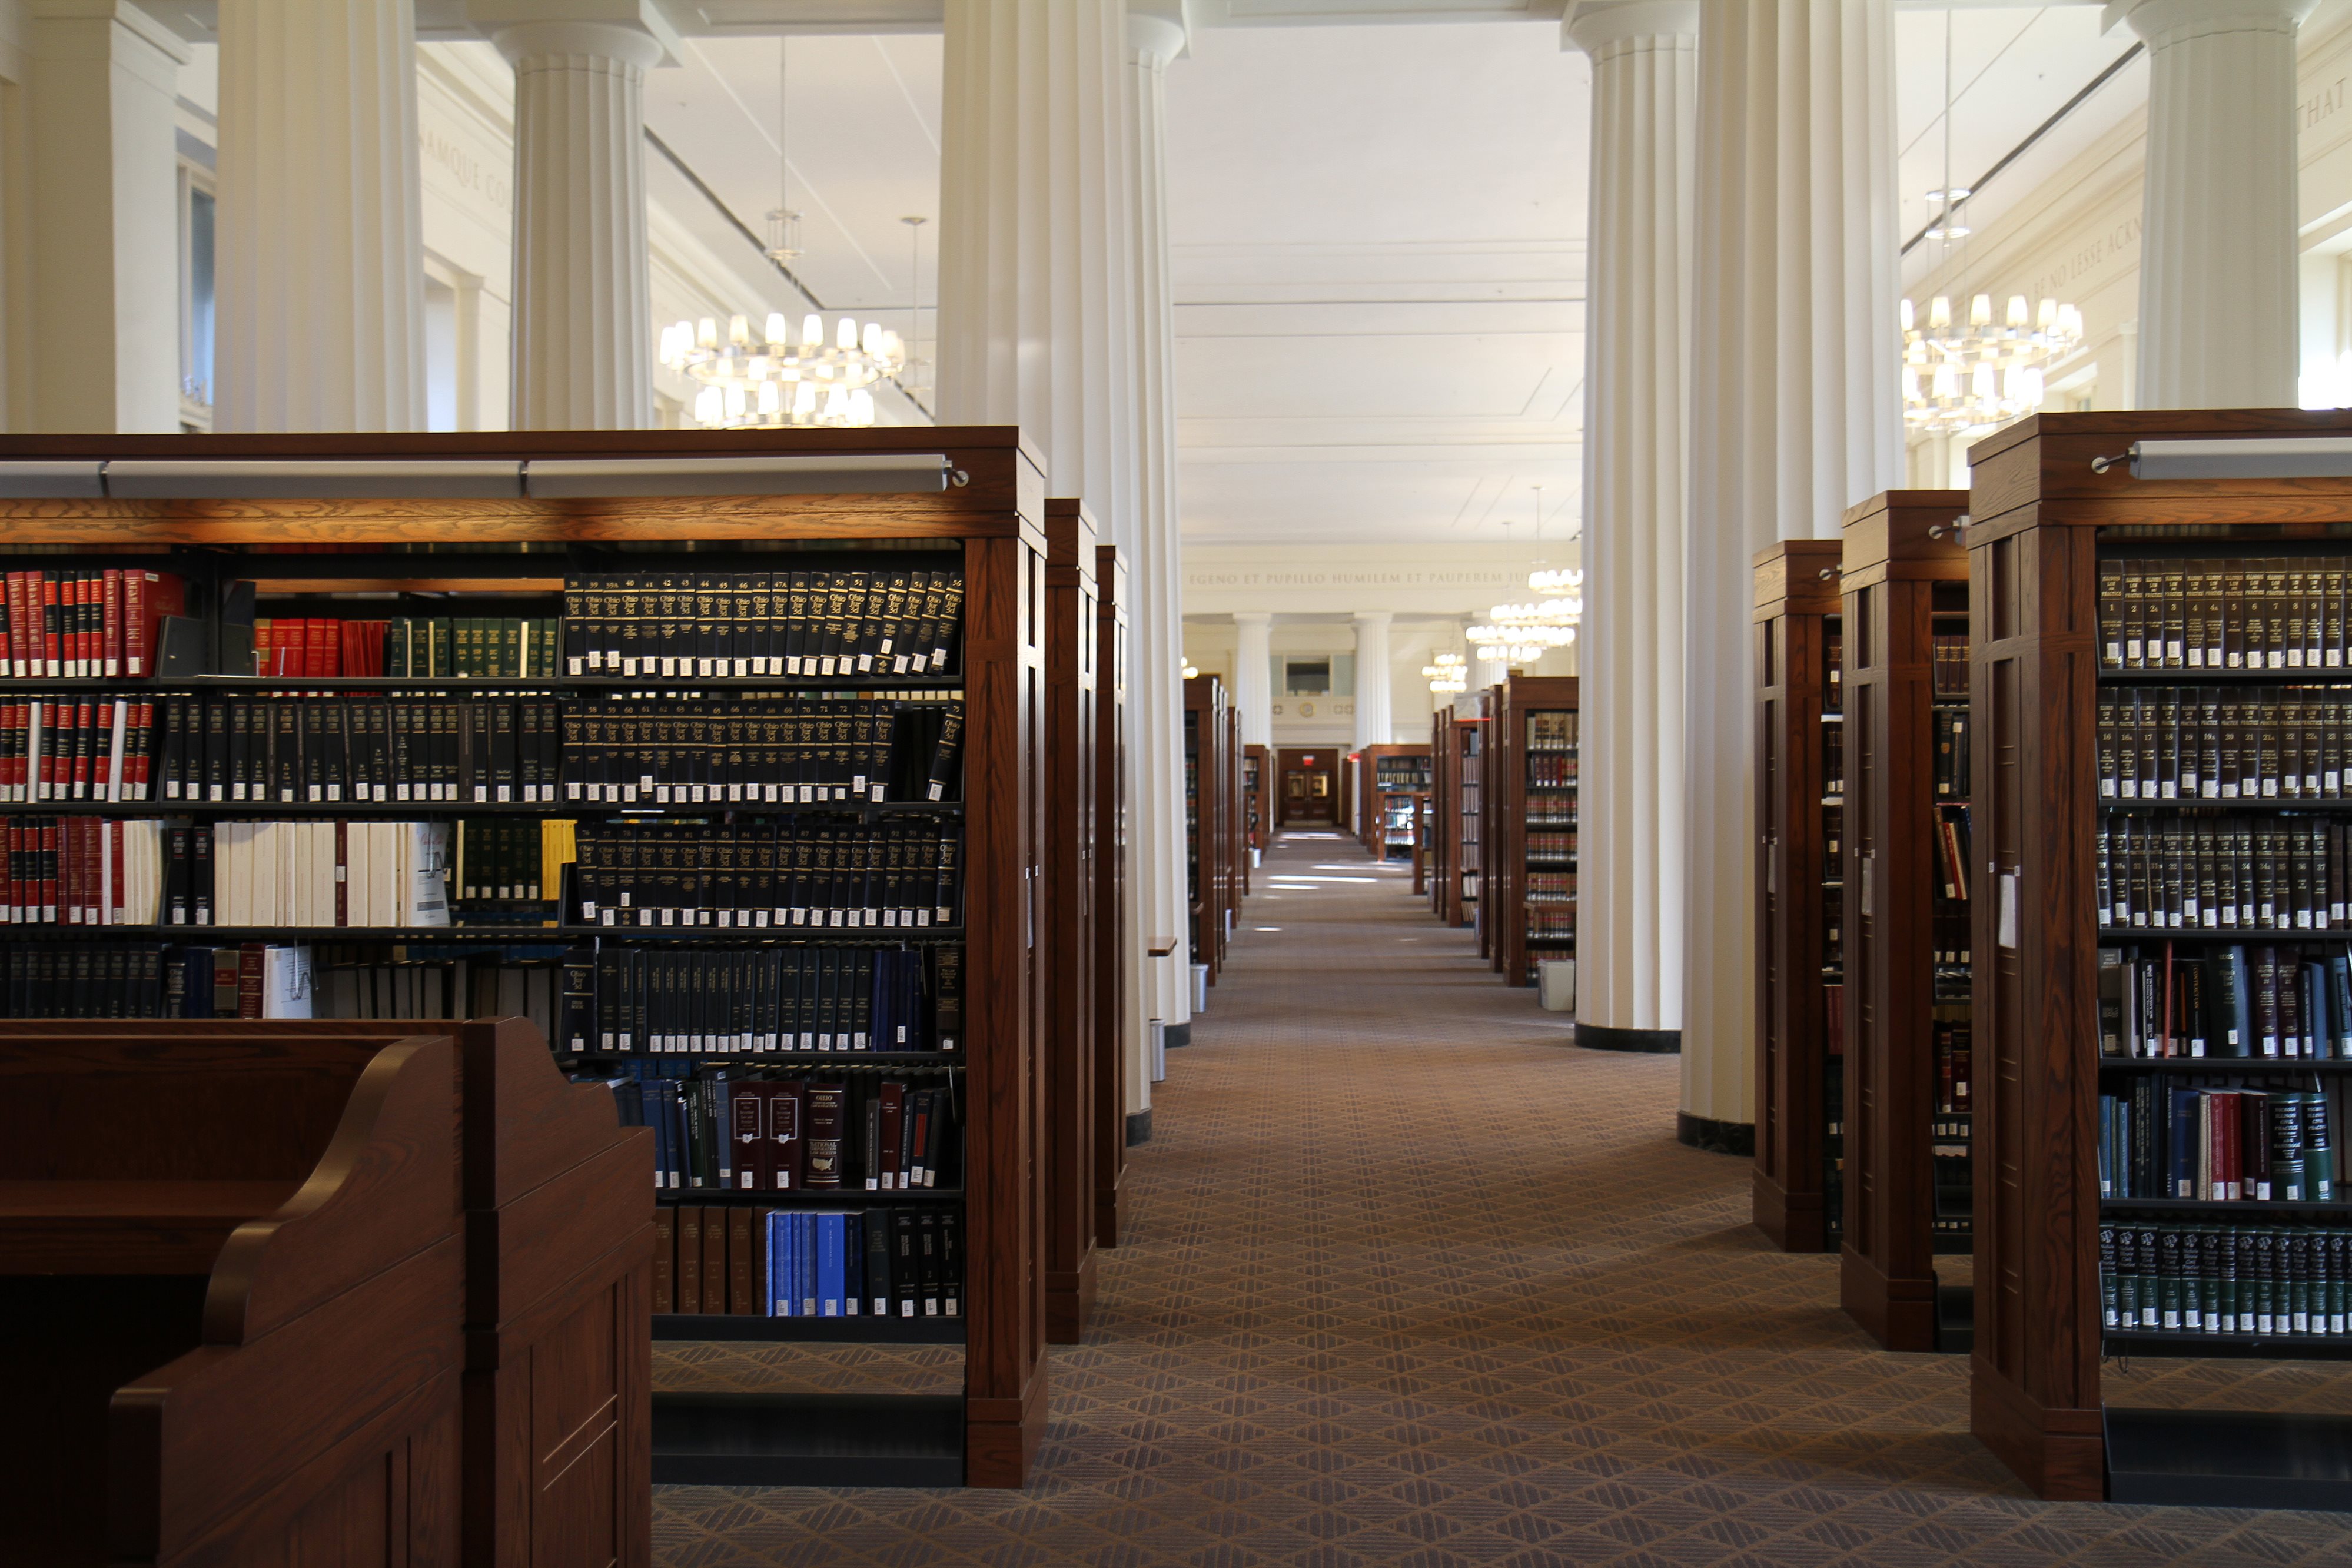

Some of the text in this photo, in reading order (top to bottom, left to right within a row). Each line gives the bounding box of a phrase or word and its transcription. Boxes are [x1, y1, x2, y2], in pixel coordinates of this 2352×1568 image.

[2294, 75, 2347, 135] THAT
[2049, 264, 2067, 293] NO
[2070, 240, 2102, 280] LESSE
[1189, 574, 1238, 585] EGENO
[1244, 574, 1260, 584] ET
[1266, 574, 1326, 584] PUPILLO
[1331, 573, 1401, 584] HUMILEM
[1407, 573, 1422, 583] ET
[1429, 572, 1502, 583] PAUPEREM
[895, 579, 904, 587] 53
[810, 595, 827, 603] Ohio
[830, 594, 846, 602] Ohio
[848, 593, 865, 602] Ohio
[869, 596, 885, 604] Ohio
[888, 593, 905, 602] Ohio
[908, 596, 922, 604] Ohio
[927, 595, 941, 603] Ohio
[945, 593, 961, 602] Ohio
[2311, 602, 2317, 610] 9
[945, 719, 961, 729] Ohio
